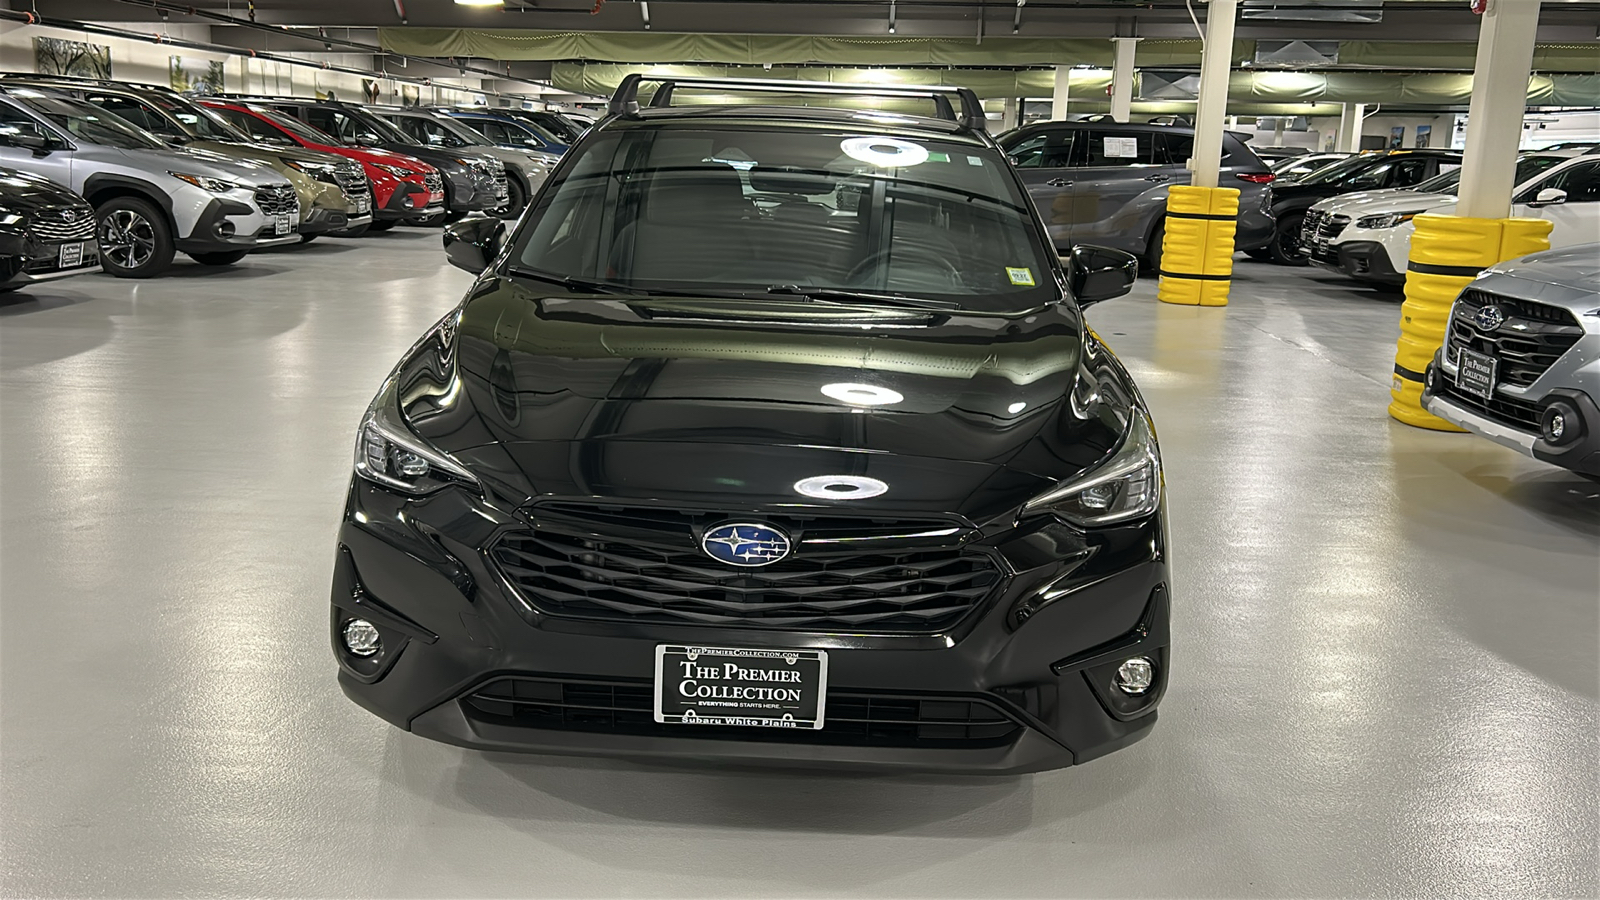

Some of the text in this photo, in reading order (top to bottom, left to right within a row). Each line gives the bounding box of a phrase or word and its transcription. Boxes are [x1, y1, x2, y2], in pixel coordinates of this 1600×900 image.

[1462, 367, 1489, 383] COLLECTION
[680, 661, 802, 683] THE PREMIER
[679, 680, 801, 701] COLLECTION
[681, 716, 797, 728] Subaru White Plains
